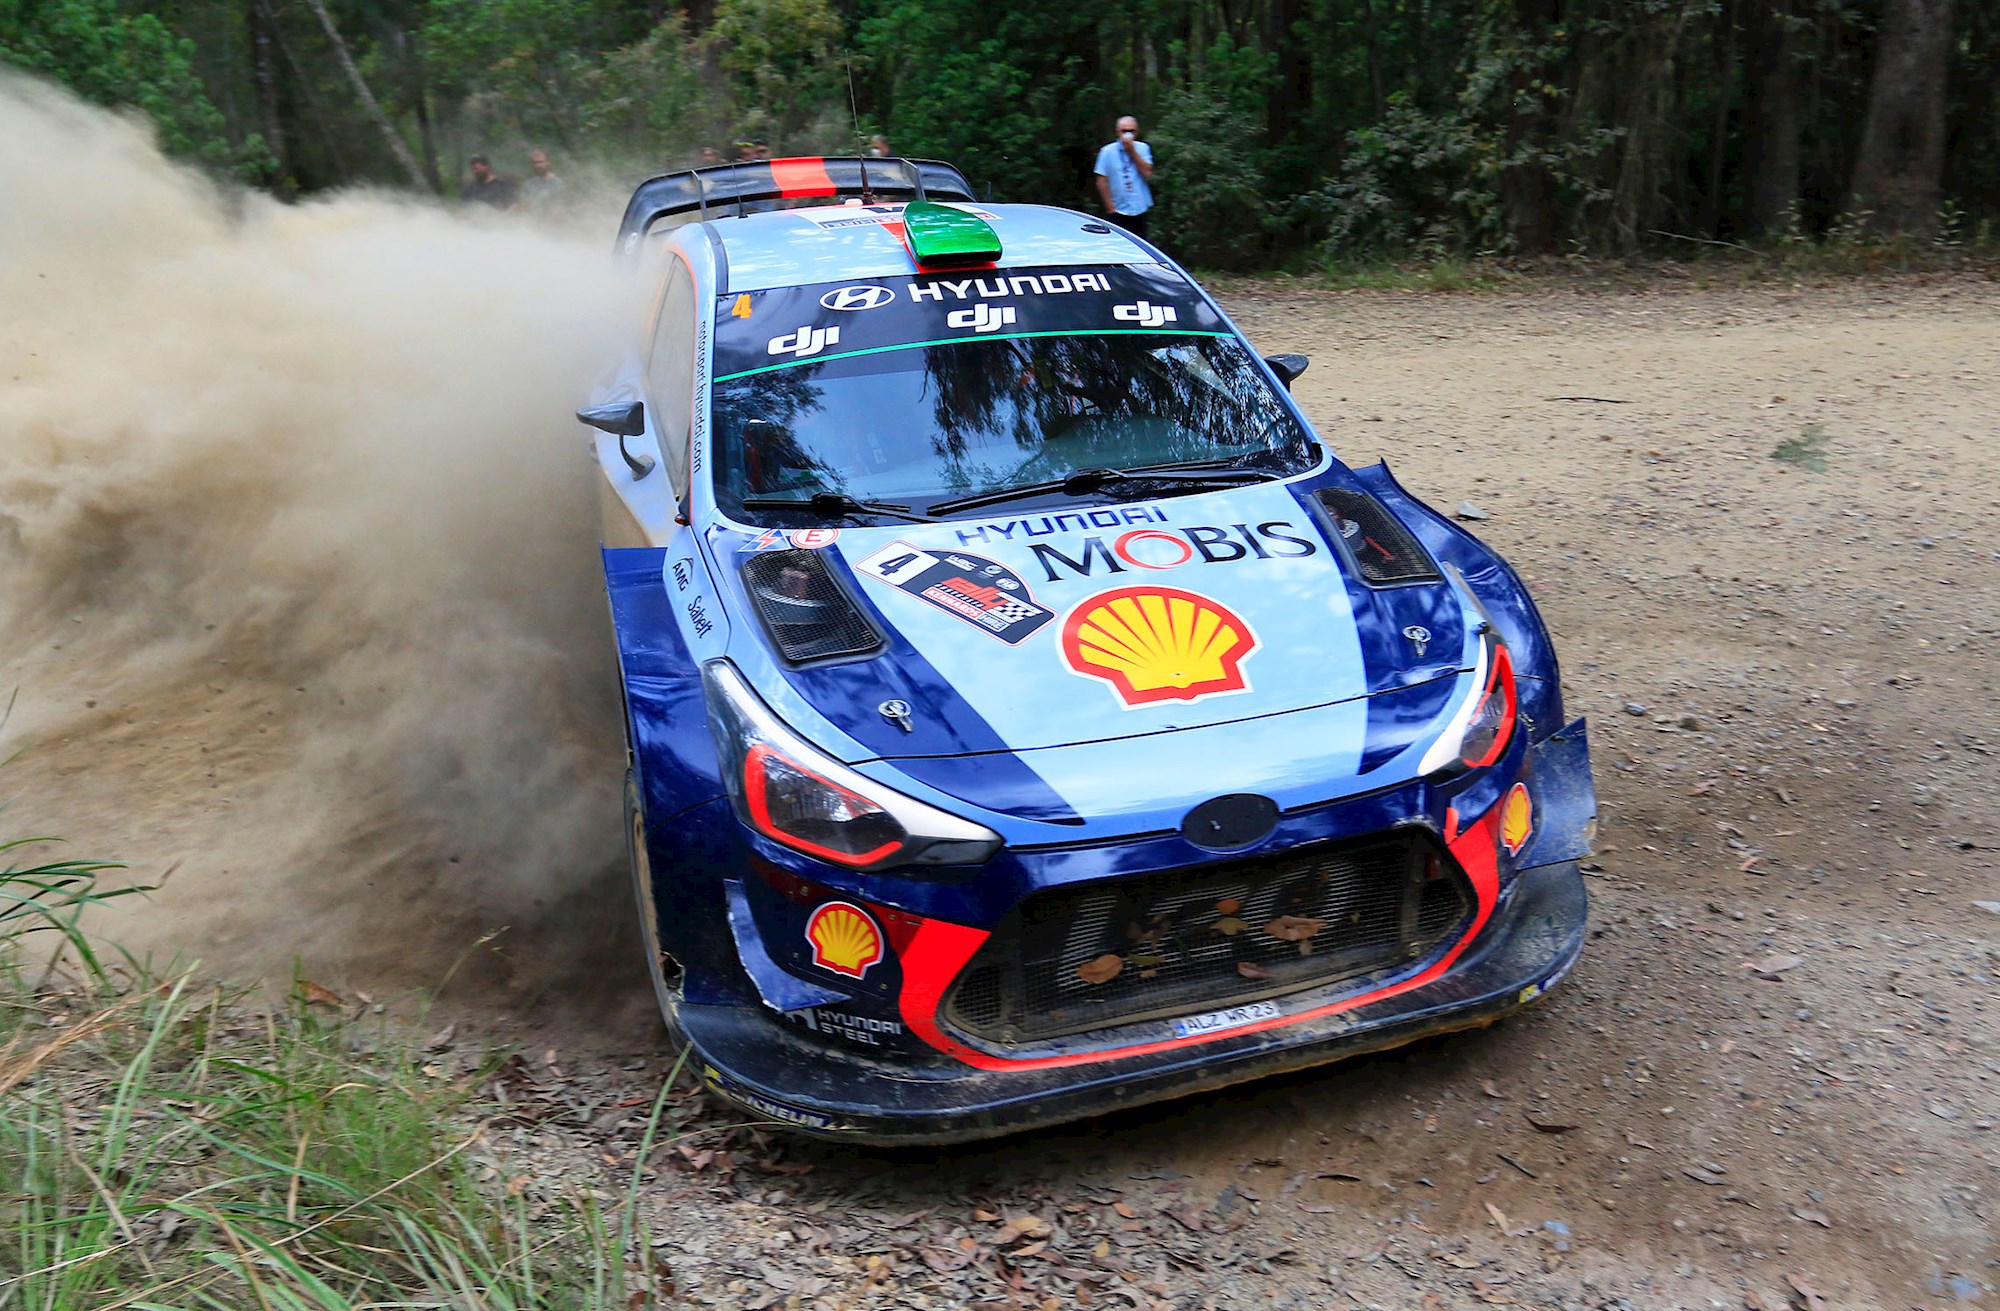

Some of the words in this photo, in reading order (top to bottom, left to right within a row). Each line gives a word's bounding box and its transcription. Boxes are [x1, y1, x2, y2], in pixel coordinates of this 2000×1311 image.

[907, 273, 1112, 303] HYUNDAI
[731, 294, 753, 320] 4
[693, 320, 708, 475] motorsport.hyundai.com
[804, 529, 824, 543] E
[954, 506, 1170, 548] HYUNDAI
[877, 552, 919, 577] 4
[1027, 521, 1317, 583] MOBIS
[672, 561, 691, 593] AMG
[687, 595, 713, 640] Sabelt
[816, 1008, 902, 1035] HYUNDAI
[822, 1022, 880, 1046] STEEL
